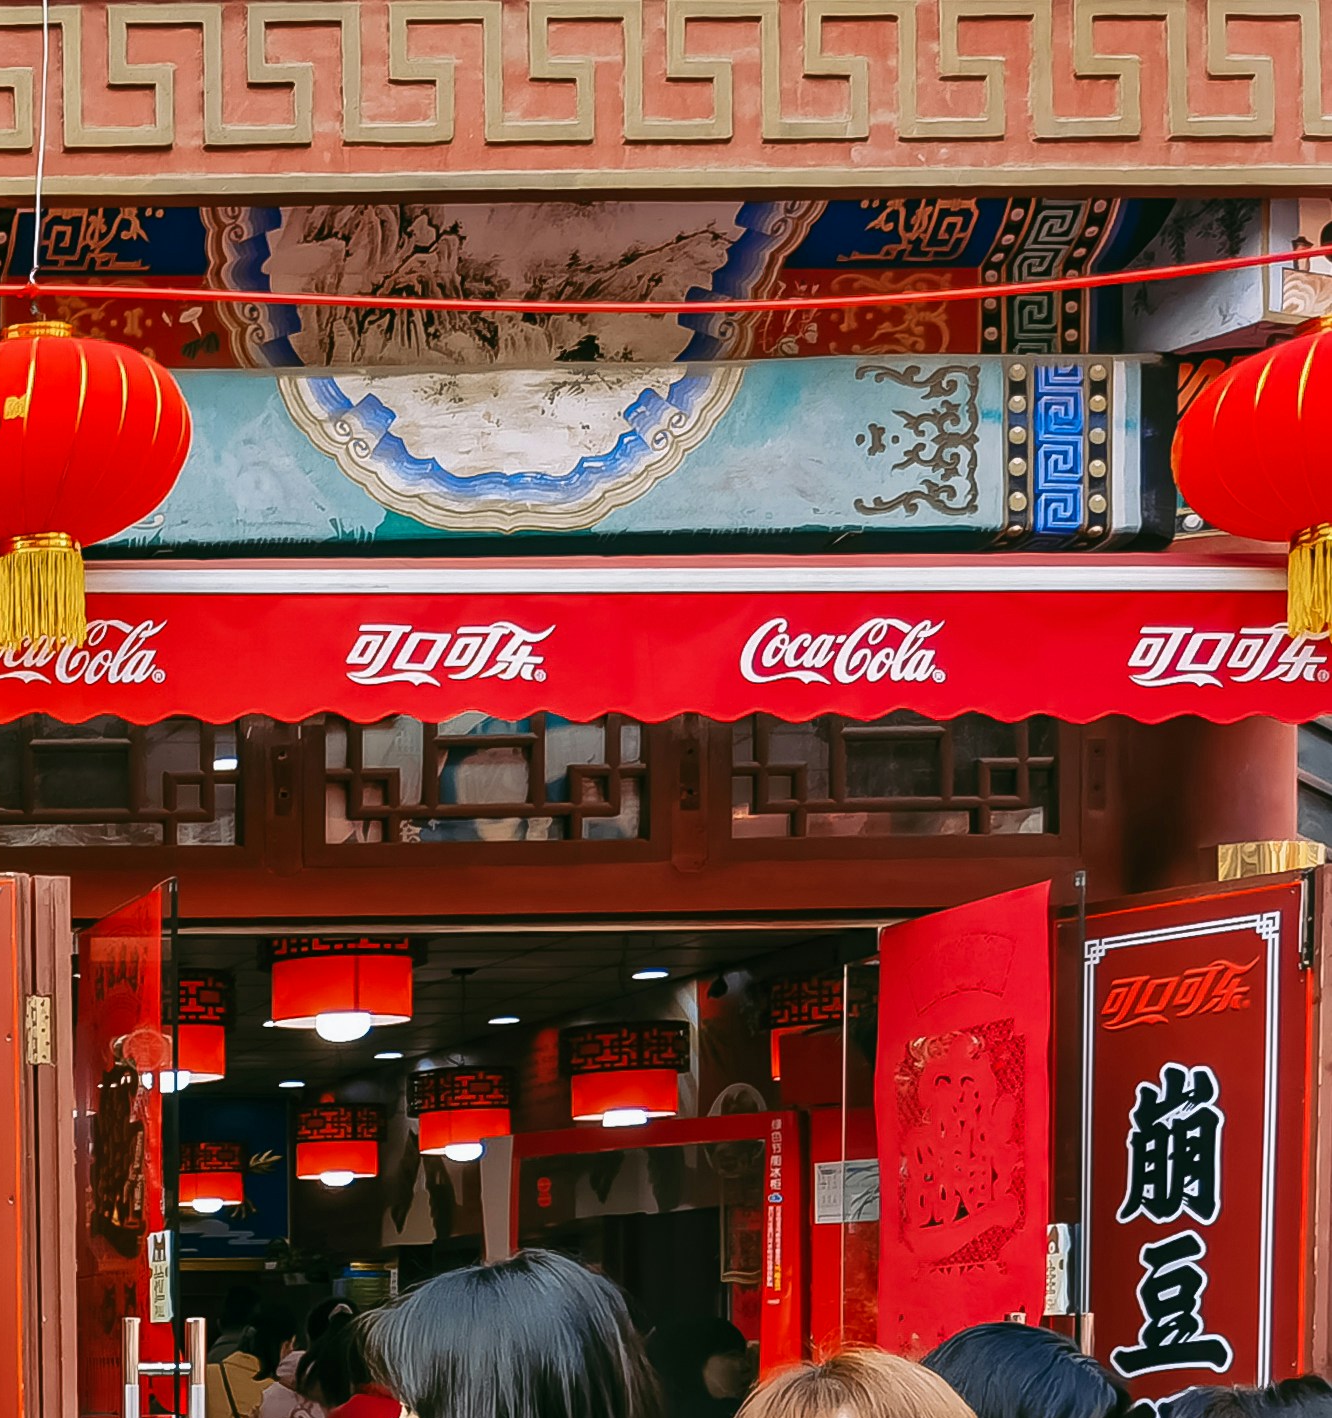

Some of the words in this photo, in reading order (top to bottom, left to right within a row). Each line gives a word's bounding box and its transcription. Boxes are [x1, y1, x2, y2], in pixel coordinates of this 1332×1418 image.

[345, 620, 556, 688] 可口可乐
[739, 617, 945, 685] Coca-Cola
[1127, 620, 1328, 689] 可口可乐
[1100, 955, 1261, 1030] 可口可乐
